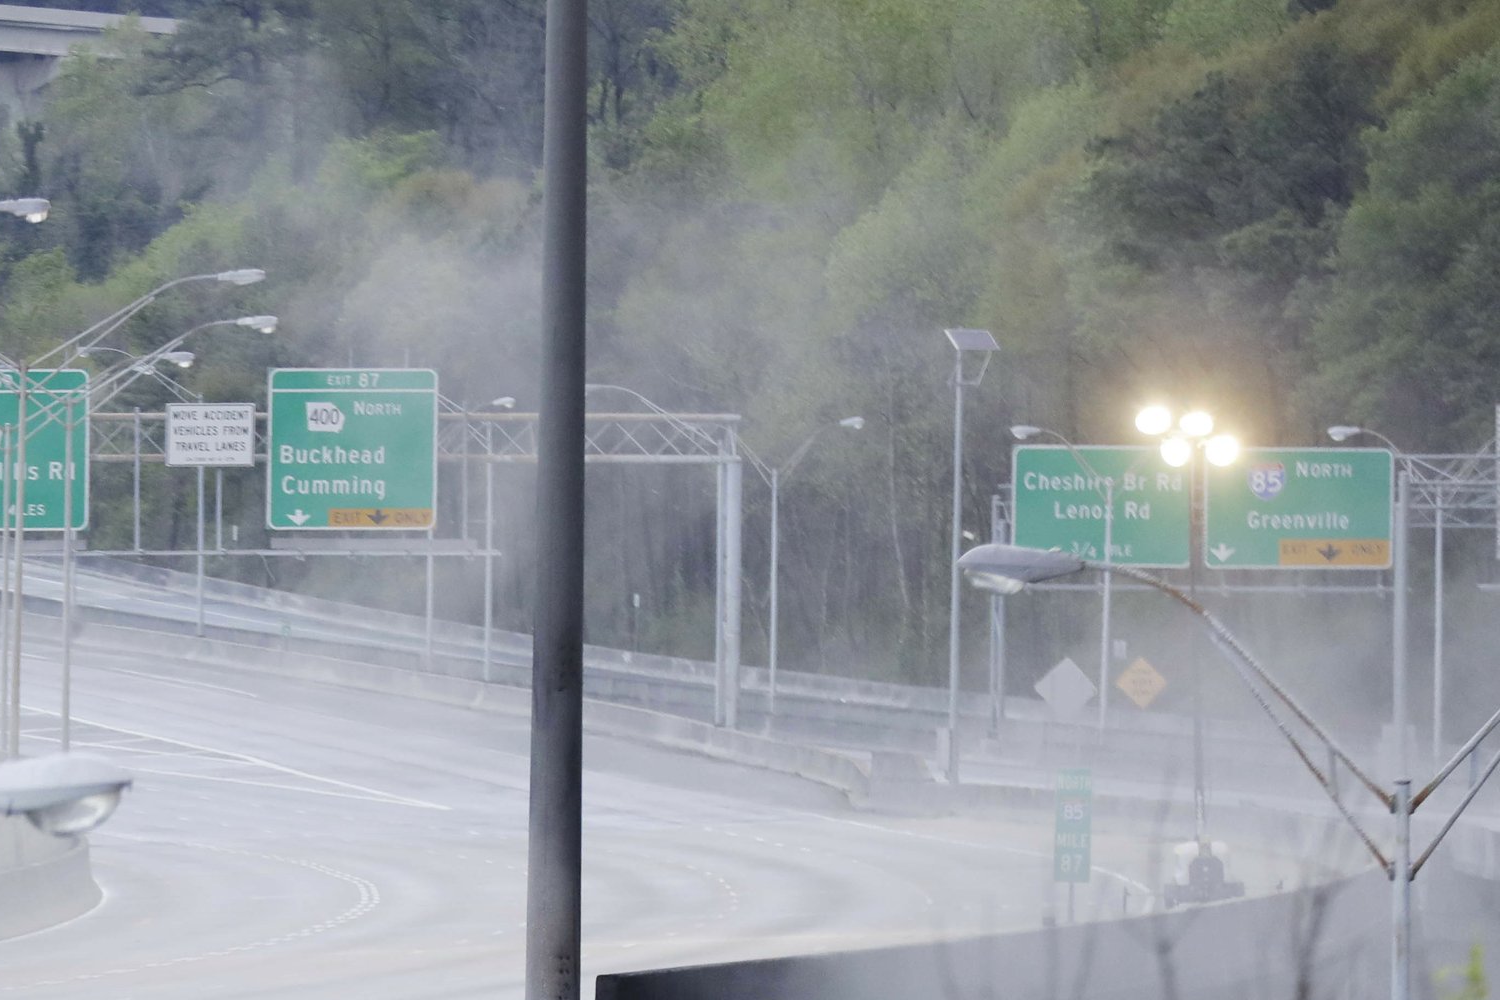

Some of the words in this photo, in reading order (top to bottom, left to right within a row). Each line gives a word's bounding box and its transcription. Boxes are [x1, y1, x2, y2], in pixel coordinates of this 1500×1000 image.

[327, 375, 351, 386] EXIT
[358, 373, 380, 388] 87
[172, 410, 198, 420] MOVE
[204, 410, 249, 420] ACCIDENT
[309, 408, 340, 425] 400
[354, 401, 402, 416] NORTH
[173, 425, 219, 436] VEHICLES
[223, 425, 248, 436] FROM
[175, 441, 211, 451] TRAVEL
[215, 441, 246, 451] LANES
[279, 444, 385, 464] Buckhead
[1023, 471, 1114, 491] Cheshire
[1123, 472, 1148, 491] Br
[1156, 472, 1183, 491] Rd
[1251, 471, 1283, 493] 85
[1295, 460, 1353, 478] NORTH
[281, 475, 386, 500] Cumming
[334, 511, 361, 524] EXIT
[394, 511, 432, 524] ONLY
[1053, 501, 1114, 520] Lenox
[1125, 501, 1151, 520] Rd
[1247, 511, 1349, 530] Greenville
[1058, 775, 1092, 790] NORTH
[1064, 803, 1084, 820] 85
[1057, 833, 1090, 849] MILE
[1060, 854, 1083, 873] 87
